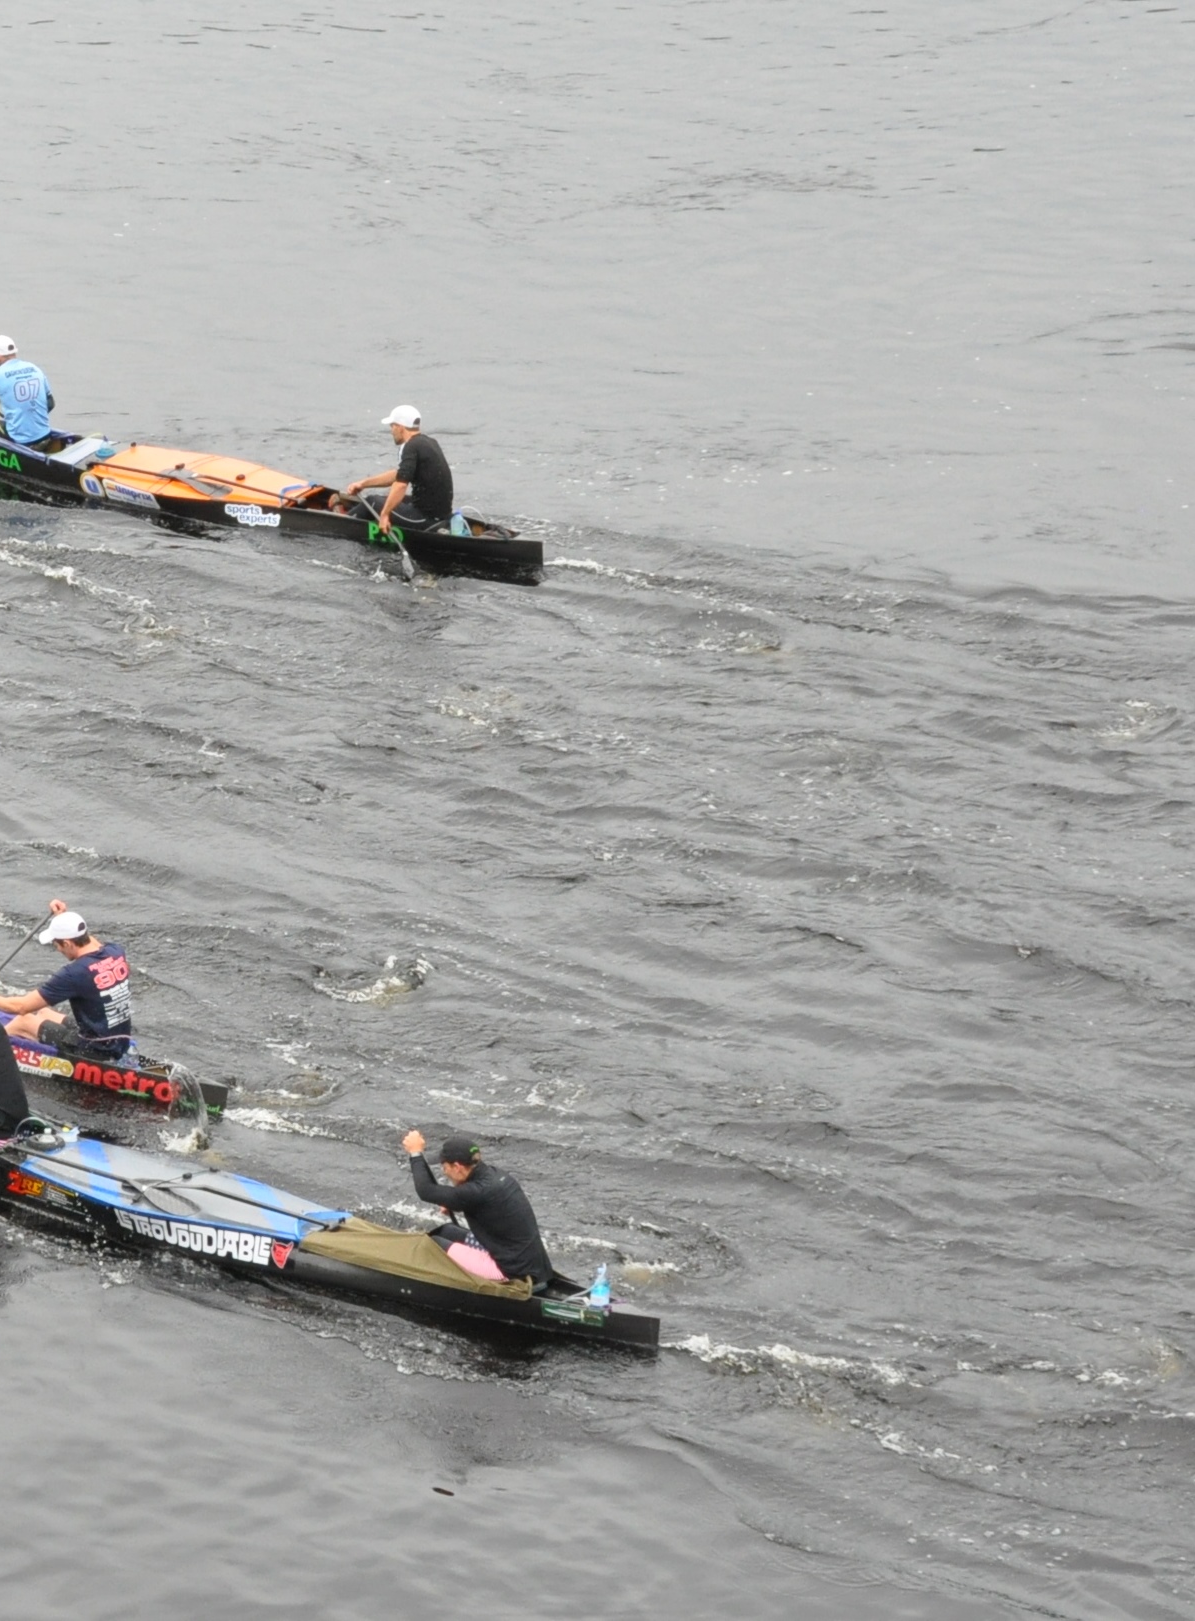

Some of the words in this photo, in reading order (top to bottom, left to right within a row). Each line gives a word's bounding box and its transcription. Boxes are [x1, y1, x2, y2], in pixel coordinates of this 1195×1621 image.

[13, 377, 40, 403] 07
[226, 504, 261, 516] sports
[239, 513, 279, 526] experts
[93, 961, 130, 991] 90
[74, 1060, 180, 1103] metro
